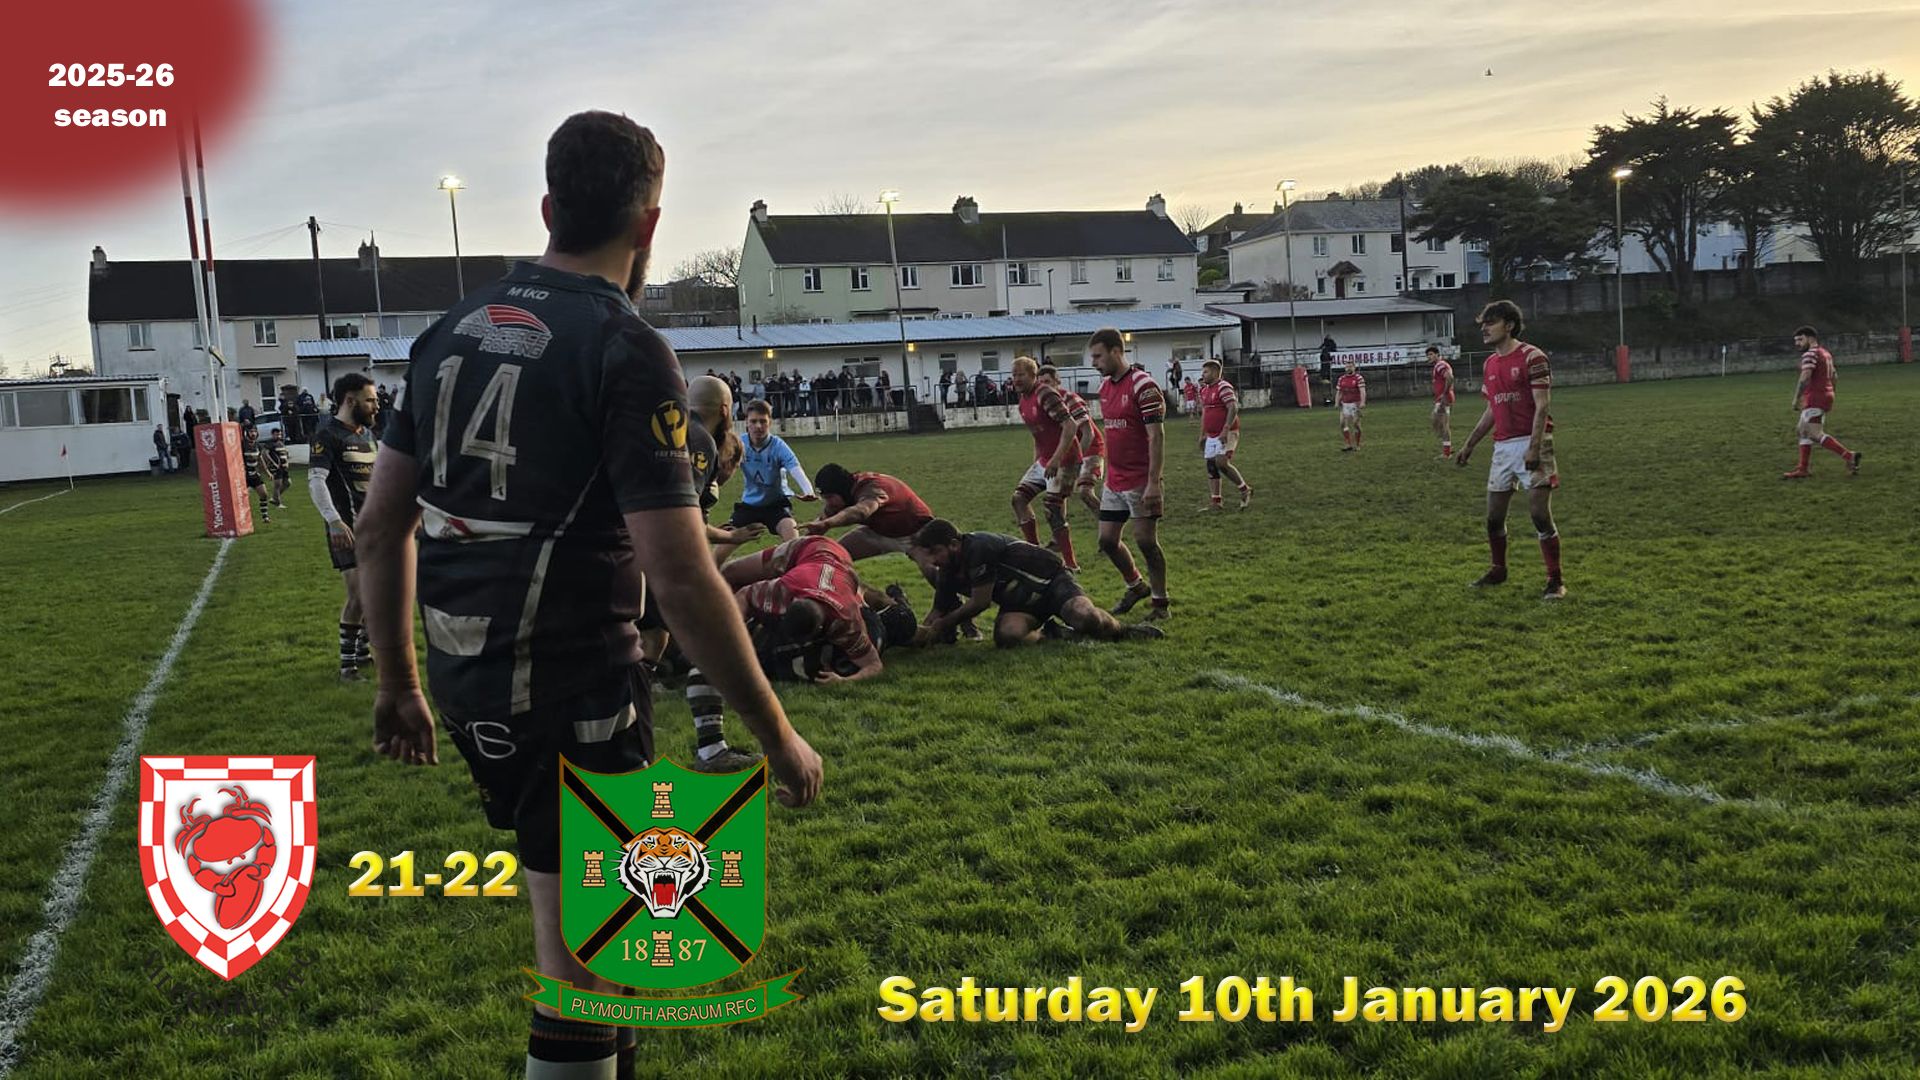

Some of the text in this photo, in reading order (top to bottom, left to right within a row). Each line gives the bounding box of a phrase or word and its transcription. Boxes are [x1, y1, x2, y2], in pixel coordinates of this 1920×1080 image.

[1330, 352, 1375, 365] ALCOMBE
[432, 355, 523, 501] 14
[208, 481, 224, 529] Yeoward
